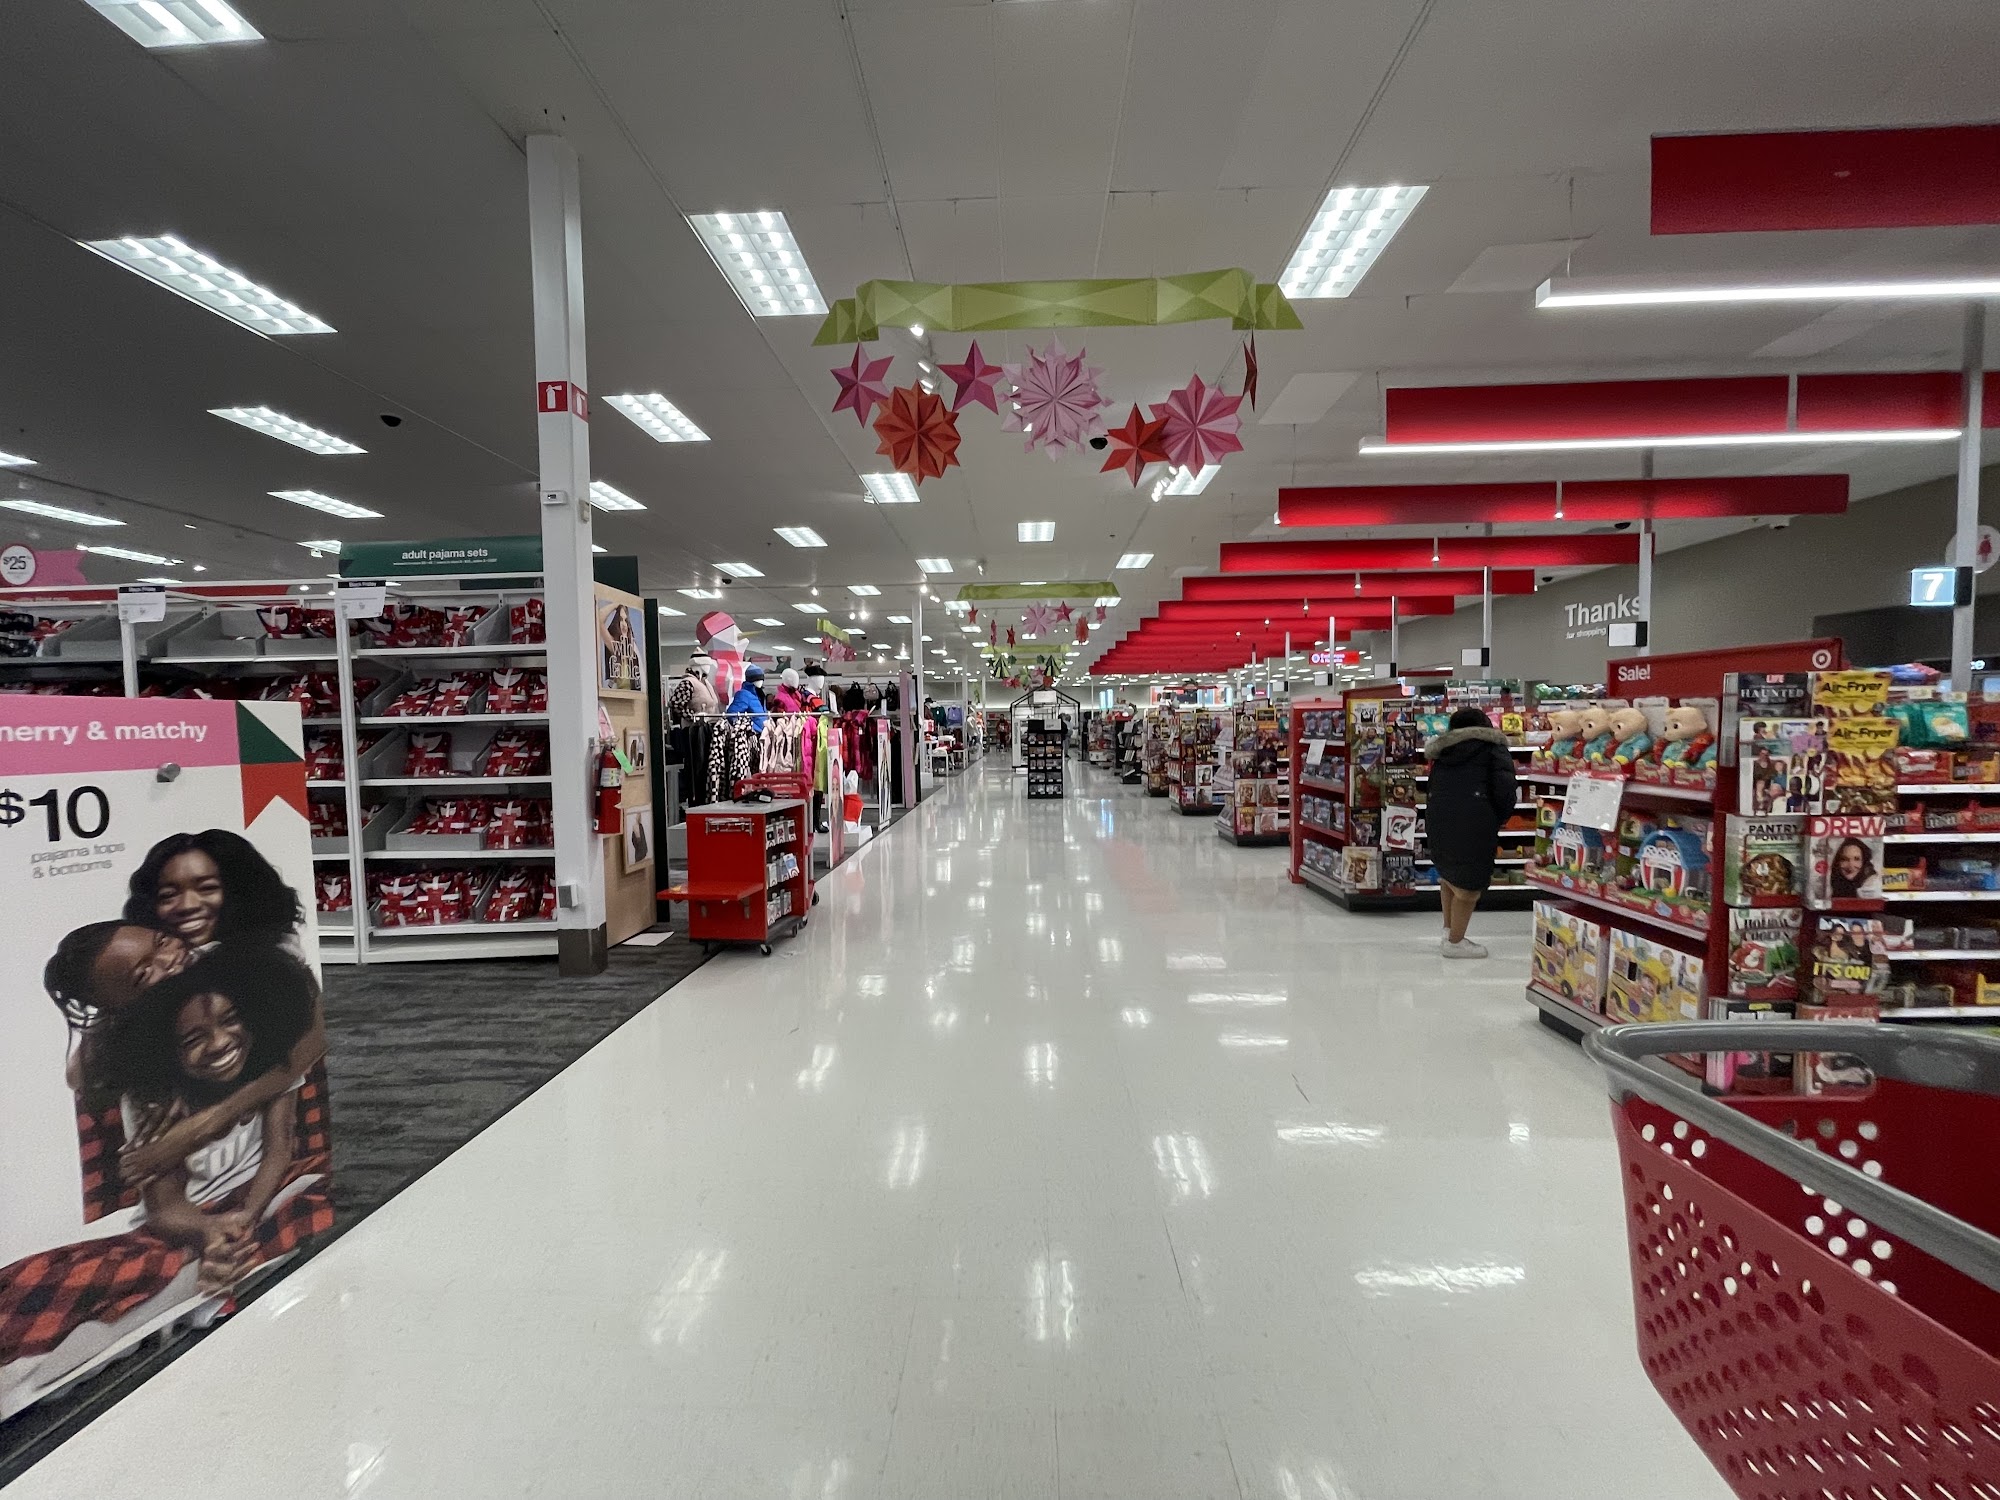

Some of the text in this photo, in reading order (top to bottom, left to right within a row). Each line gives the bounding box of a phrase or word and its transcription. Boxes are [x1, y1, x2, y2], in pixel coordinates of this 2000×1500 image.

[3, 555, 26, 570] $25
[402, 547, 489, 560] adult pajama sets
[1922, 573, 1944, 601] 7
[1564, 594, 1640, 628] Thanks
[1577, 627, 1606, 638] shopping
[1618, 664, 1651, 681] Sale!
[1741, 689, 1804, 698] HAUNTED
[87, 721, 108, 740] &
[115, 721, 207, 742] matchy
[0, 786, 110, 842] $10
[1749, 824, 1799, 834] PANTRY
[1812, 816, 1884, 838] DREW
[31, 842, 126, 863] pajama tops
[33, 859, 113, 879] & bottoms
[1813, 962, 1842, 978] IT'S
